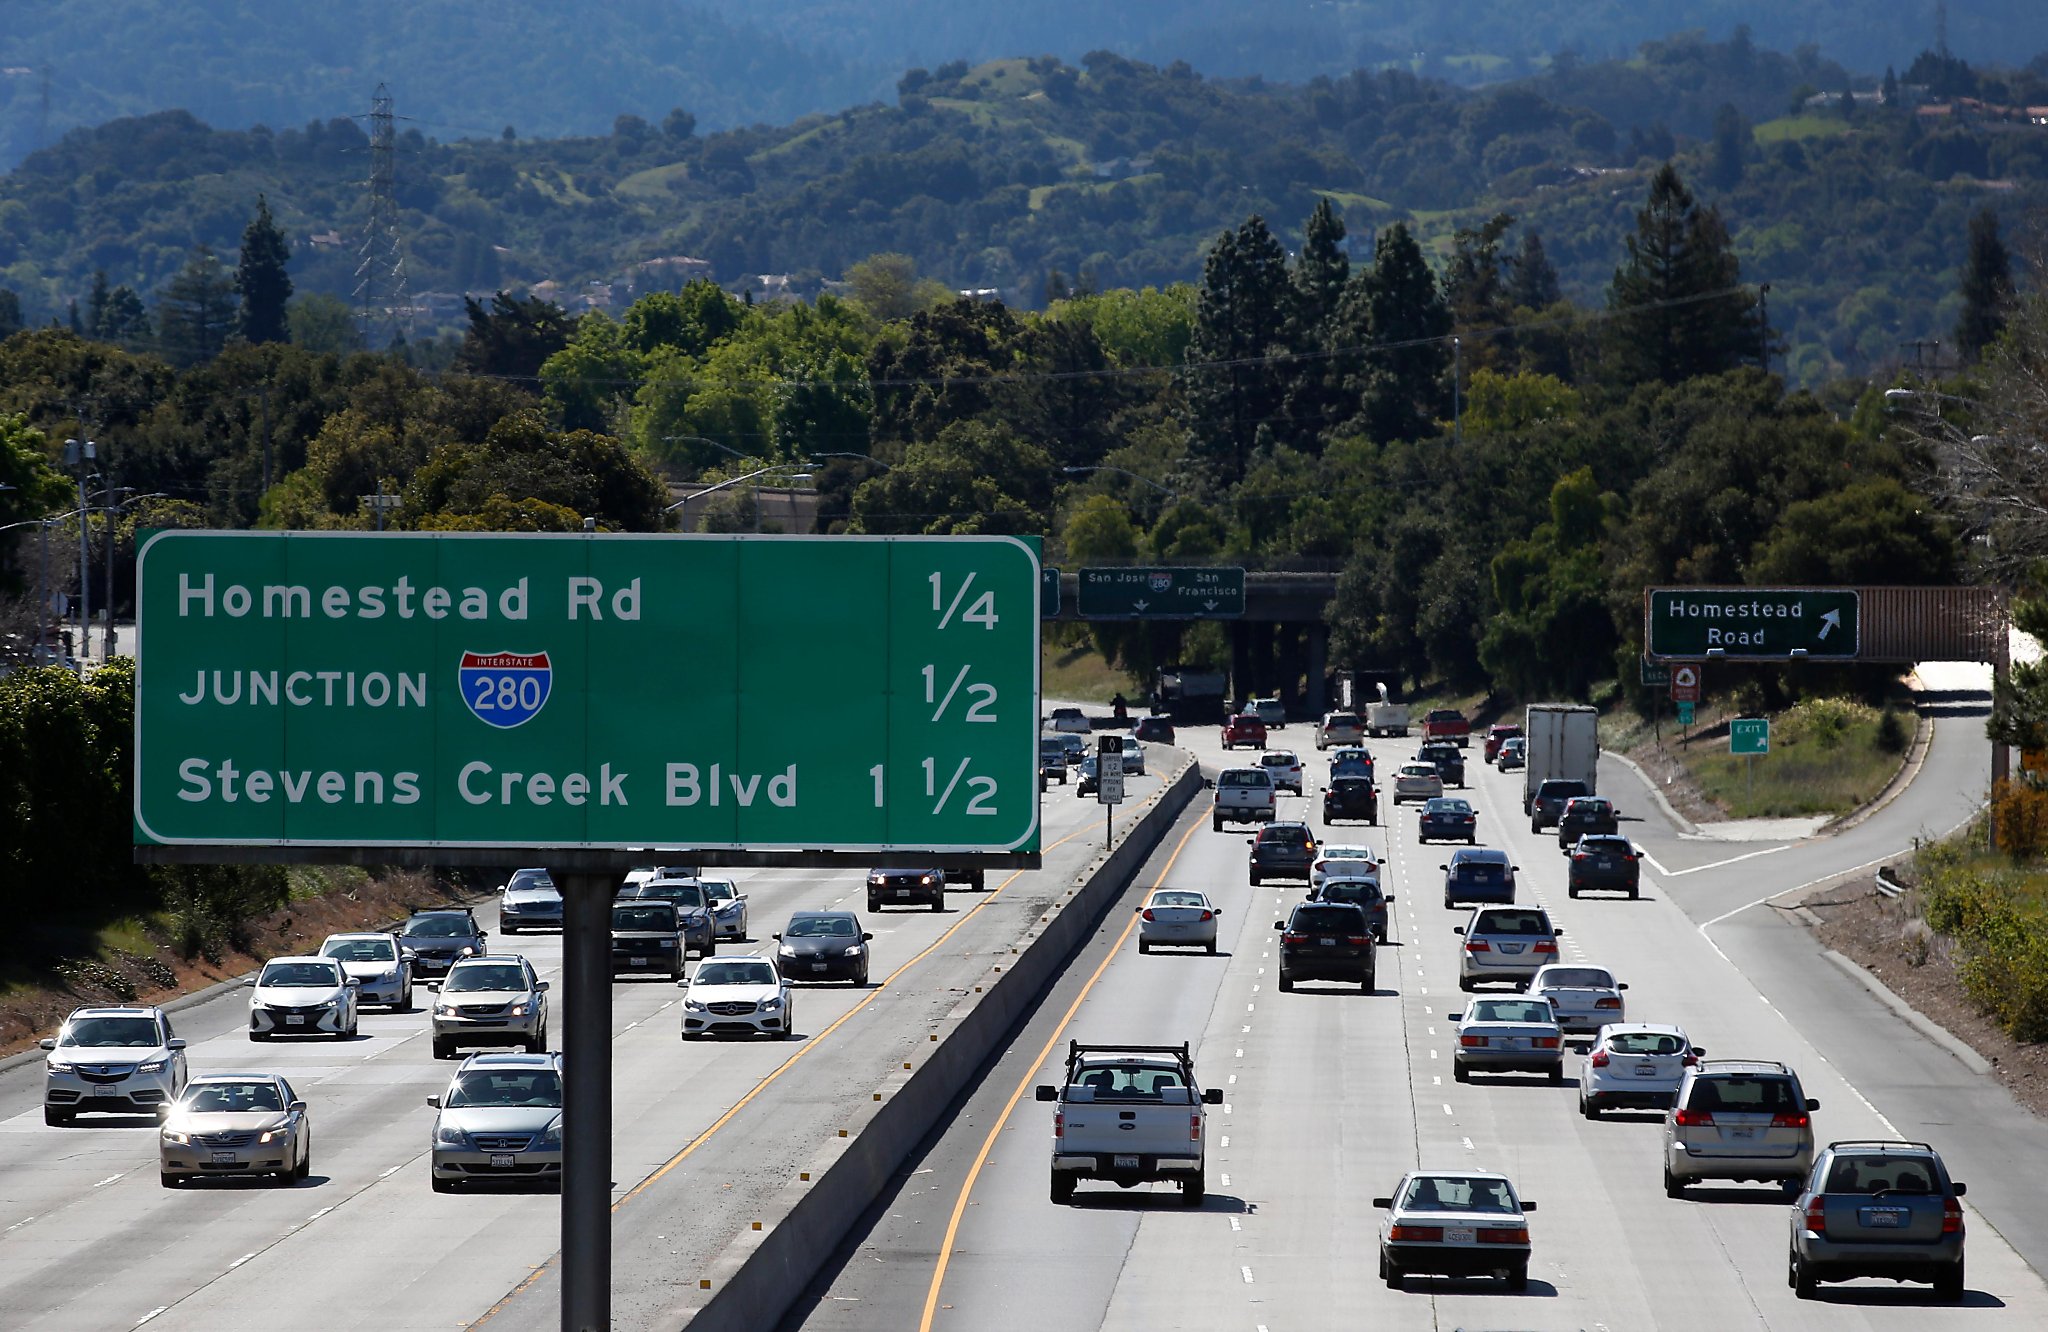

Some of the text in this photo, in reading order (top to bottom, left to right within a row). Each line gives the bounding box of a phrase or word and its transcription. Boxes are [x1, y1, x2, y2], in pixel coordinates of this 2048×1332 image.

[1088, 573, 1145, 583] San Jose
[1196, 573, 1219, 583] San
[1178, 586, 1237, 596] Francisco
[179, 571, 999, 630] Homestead Rd 1/4
[1669, 600, 1803, 618] Homestead
[1707, 628, 1765, 645] Road
[476, 657, 534, 667] INTERSTATE
[178, 670, 427, 707] JUNCTION
[474, 676, 541, 711] 280
[921, 664, 998, 723] 1/2
[1736, 724, 1761, 734] EXIT
[177, 757, 998, 815] Stevens Creek Blvd 1 1/2
